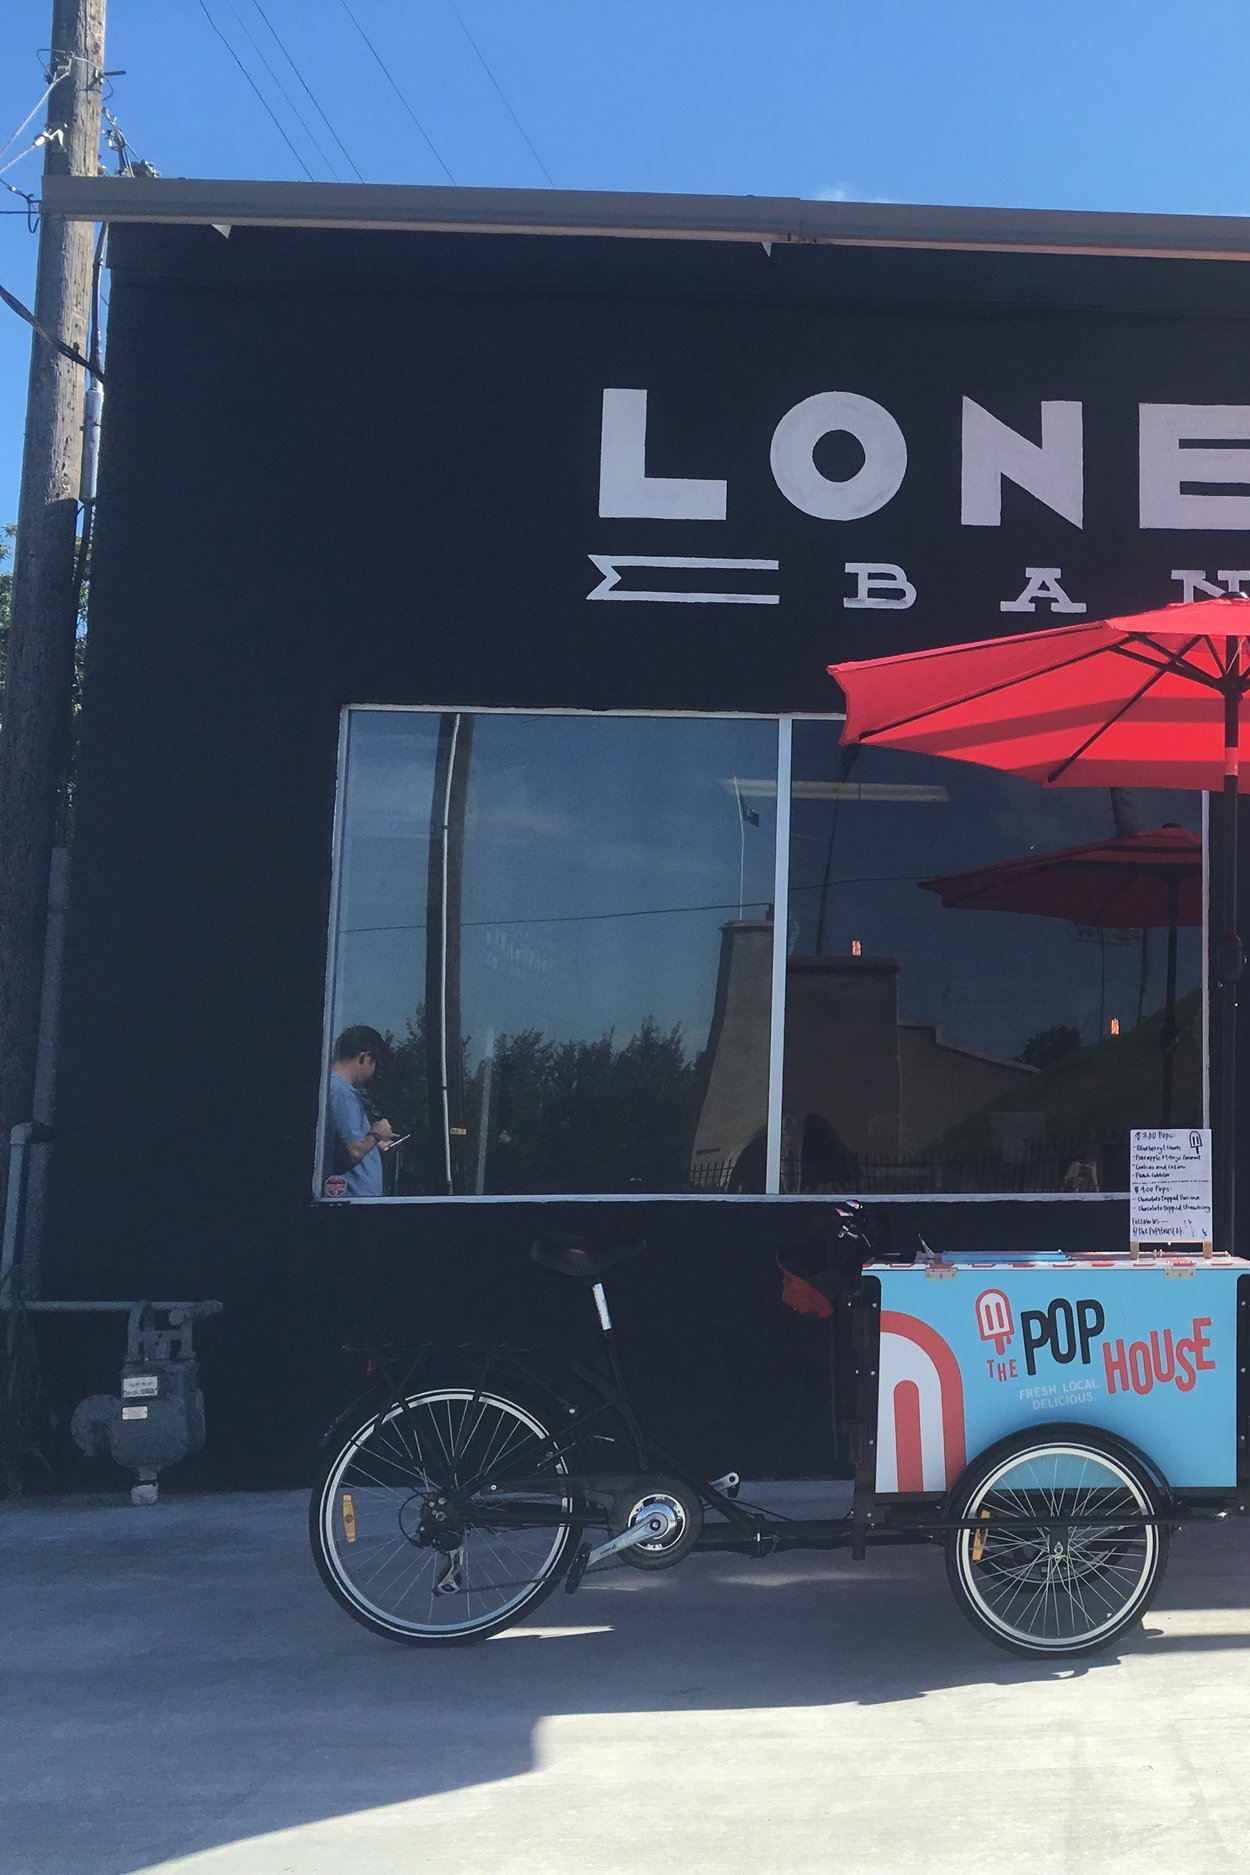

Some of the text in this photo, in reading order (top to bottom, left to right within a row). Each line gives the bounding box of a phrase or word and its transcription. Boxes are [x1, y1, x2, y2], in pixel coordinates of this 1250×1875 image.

[987, 1298, 1106, 1382] THE POP
[1102, 1317, 1216, 1395] HOUSE
